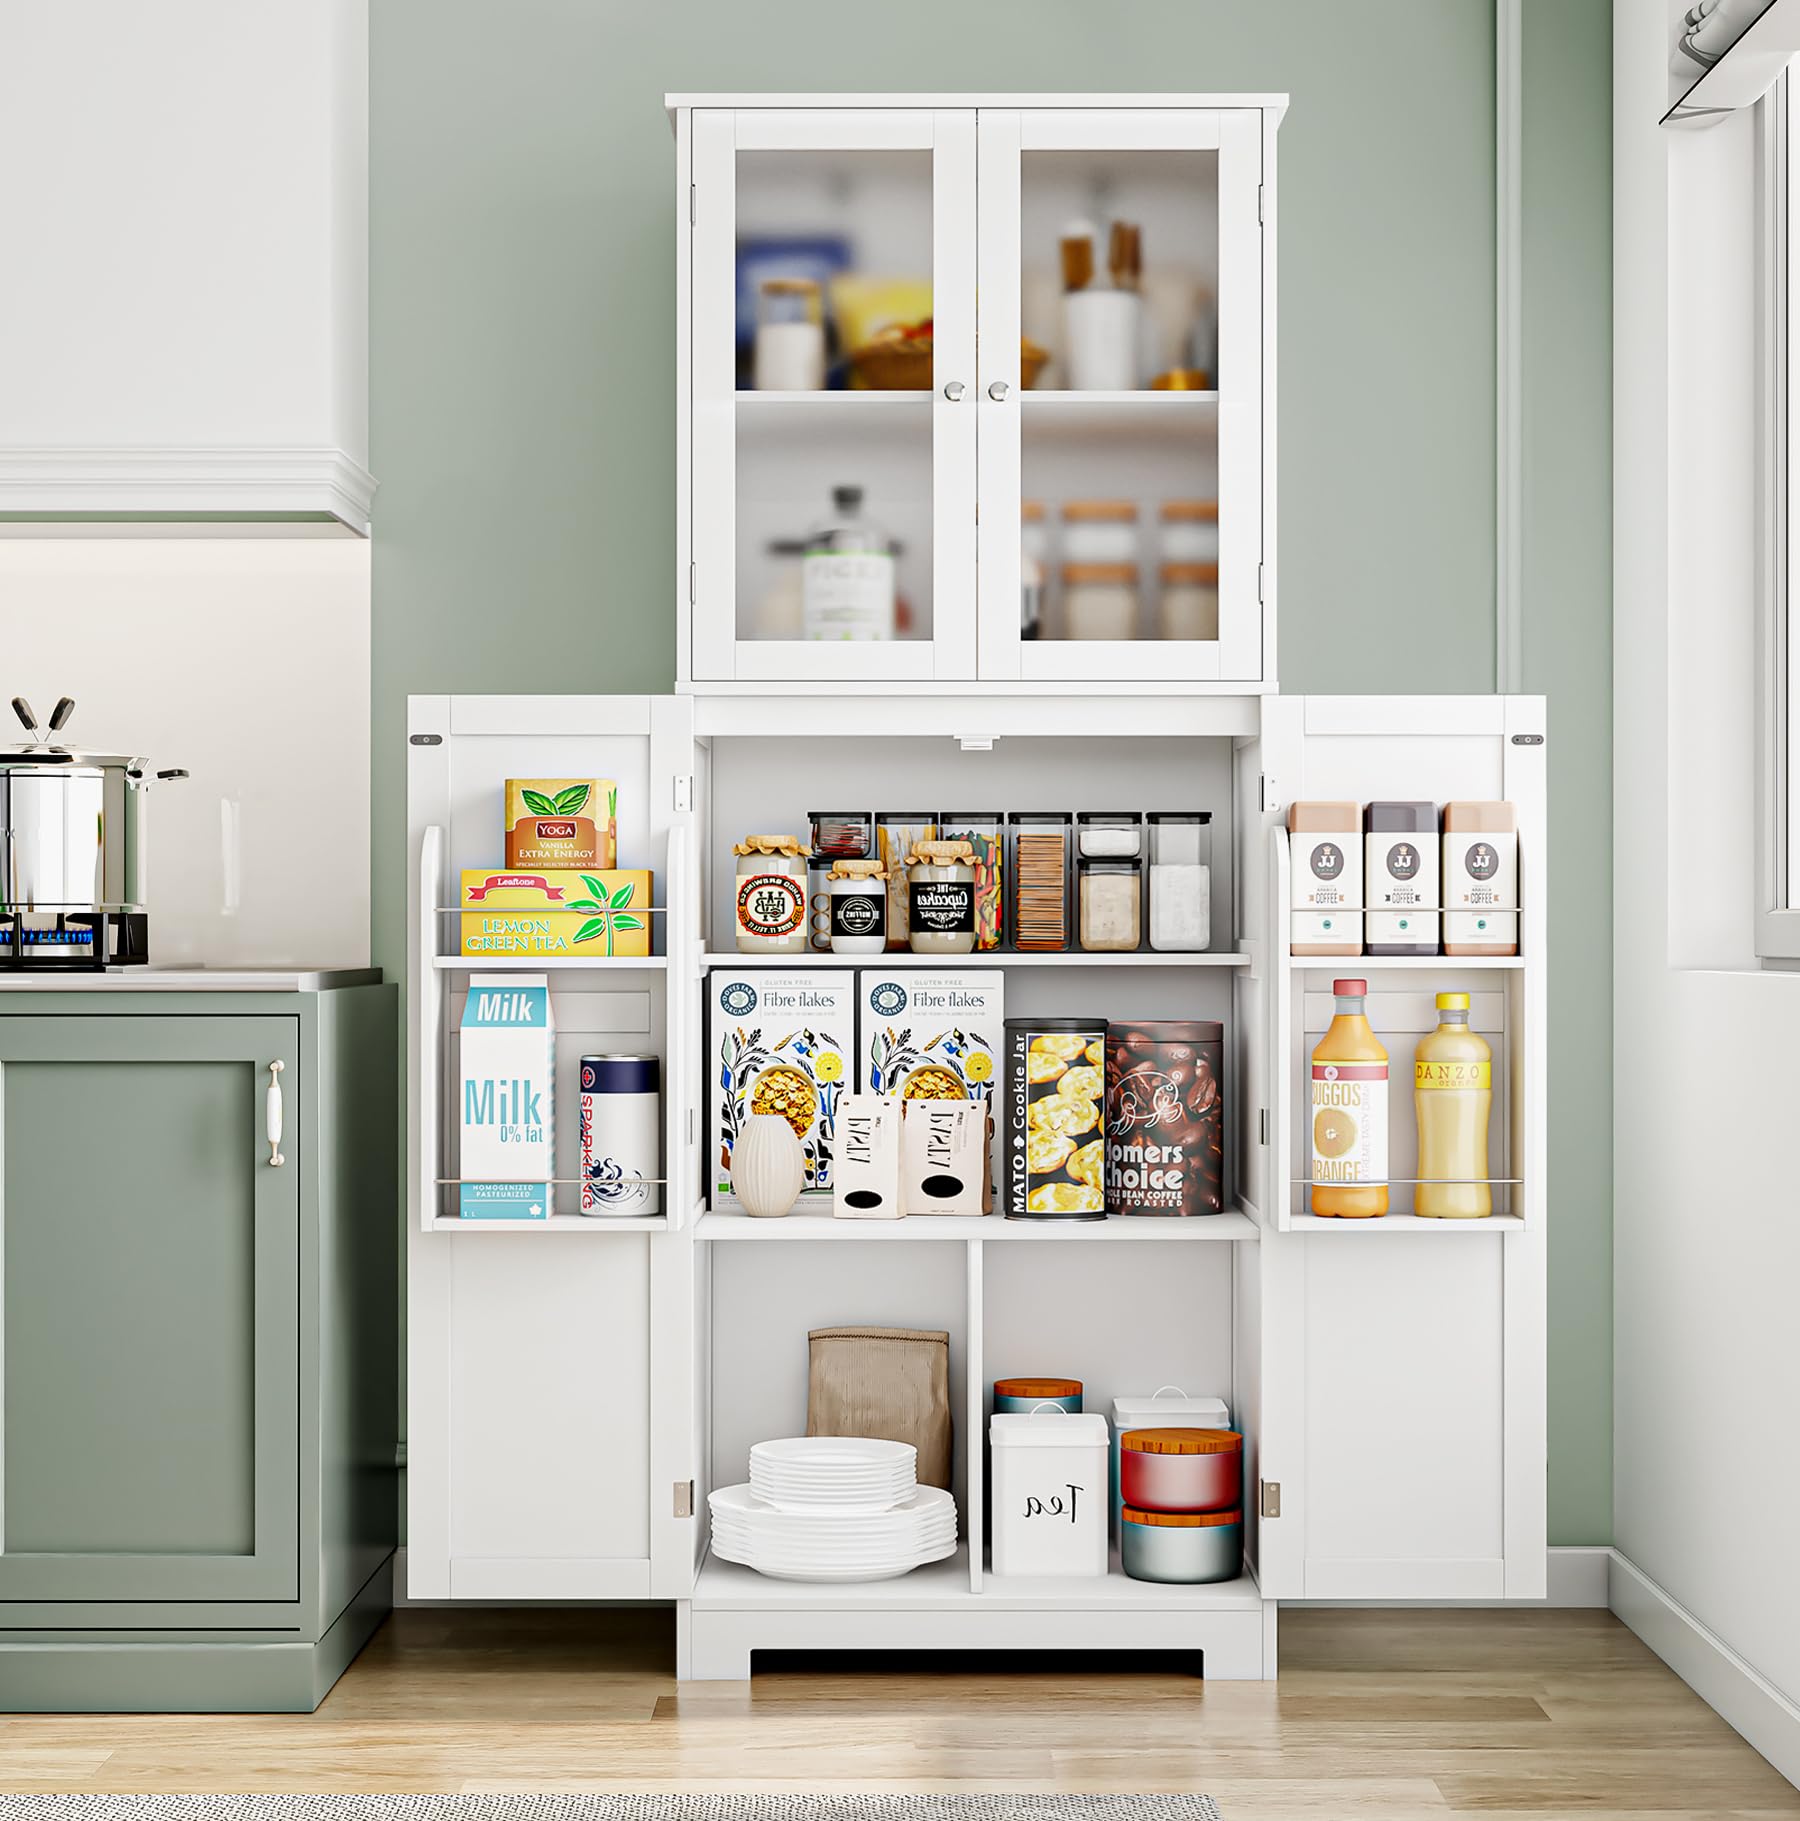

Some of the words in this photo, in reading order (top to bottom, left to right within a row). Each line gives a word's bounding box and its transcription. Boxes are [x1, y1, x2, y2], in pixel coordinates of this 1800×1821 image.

[539, 825, 573, 836] YOGA
[539, 841, 574, 849] VANILLA
[519, 848, 551, 858] EXTRA
[553, 848, 594, 858] ENERGY
[1317, 855, 1336, 868] JJ
[1394, 855, 1413, 868] JJ
[1472, 855, 1491, 868] JJ
[496, 877, 535, 887] Leaftone
[1316, 892, 1338, 903] COFFEE
[1392, 892, 1414, 903] COFFEE
[1470, 892, 1492, 903] COFFEE
[482, 918, 550, 934] LEMON
[466, 936, 529, 950] GREEN
[533, 936, 569, 950] TEA
[763, 991, 796, 1007] Fibre
[799, 991, 835, 1007] flakes
[913, 991, 946, 1007] Fibre
[949, 991, 985, 1007] flakes
[477, 993, 534, 1022] Milk
[1013, 1034, 1026, 1060] Jar
[1416, 1064, 1480, 1080] DANZO
[465, 1079, 542, 1125] Milk
[1013, 1066, 1025, 1129] Cookie
[500, 1125, 521, 1143] 0%
[526, 1125, 543, 1143] fat
[582, 1095, 593, 1209] SPARKLING
[1013, 1157, 1025, 1213] MATO
[1122, 1190, 1145, 1199] BEAN
[1147, 1191, 1183, 1200] COFFEE
[1127, 1199, 1183, 1207] ROASTED
